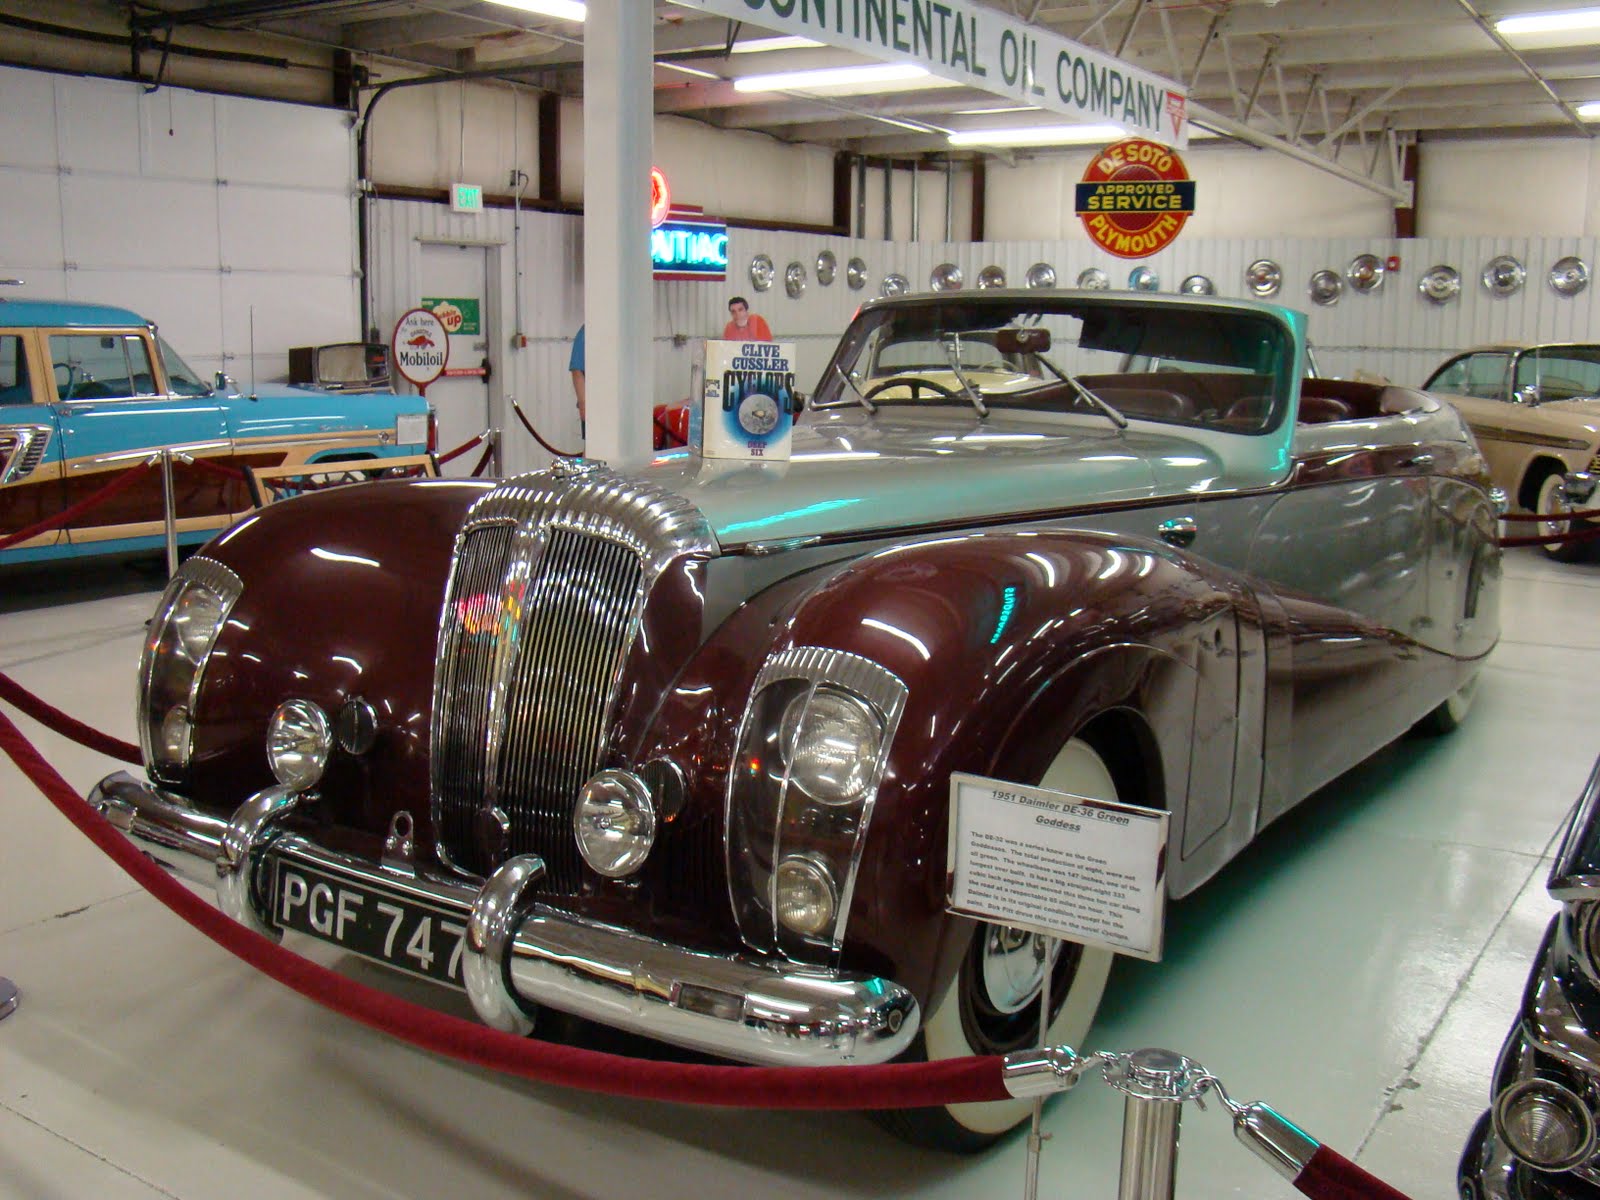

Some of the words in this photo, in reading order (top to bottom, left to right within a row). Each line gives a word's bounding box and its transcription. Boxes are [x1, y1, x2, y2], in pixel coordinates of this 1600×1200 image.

[744, 0, 986, 77] INENTAL
[1000, 29, 1046, 97] OIL
[1056, 50, 1163, 132] COMPANY
[1095, 184, 1175, 195] APPROVED
[457, 187, 480, 209] EXIT
[1087, 195, 1182, 209] SERVICE
[1089, 214, 1178, 252] PLYMOUTH
[651, 230, 728, 266] NTIAC
[405, 317, 418, 326] Ask
[420, 317, 434, 326] here
[447, 315, 461, 327] up
[741, 344, 780, 358] CLIVE
[400, 352, 443, 366] Mobiloil
[732, 357, 789, 372] CUSSLER
[722, 370, 795, 415] CYCLOPS
[991, 790, 1016, 803] 1951
[1019, 796, 1060, 812] Daimler
[1062, 804, 1094, 818] DE-36
[1097, 811, 1130, 825] Green
[1036, 815, 1081, 832] Goddess
[1010, 848, 1023, 856] The
[1003, 857, 1015, 865] The
[282, 872, 364, 941] PGF
[376, 902, 466, 979] 747
